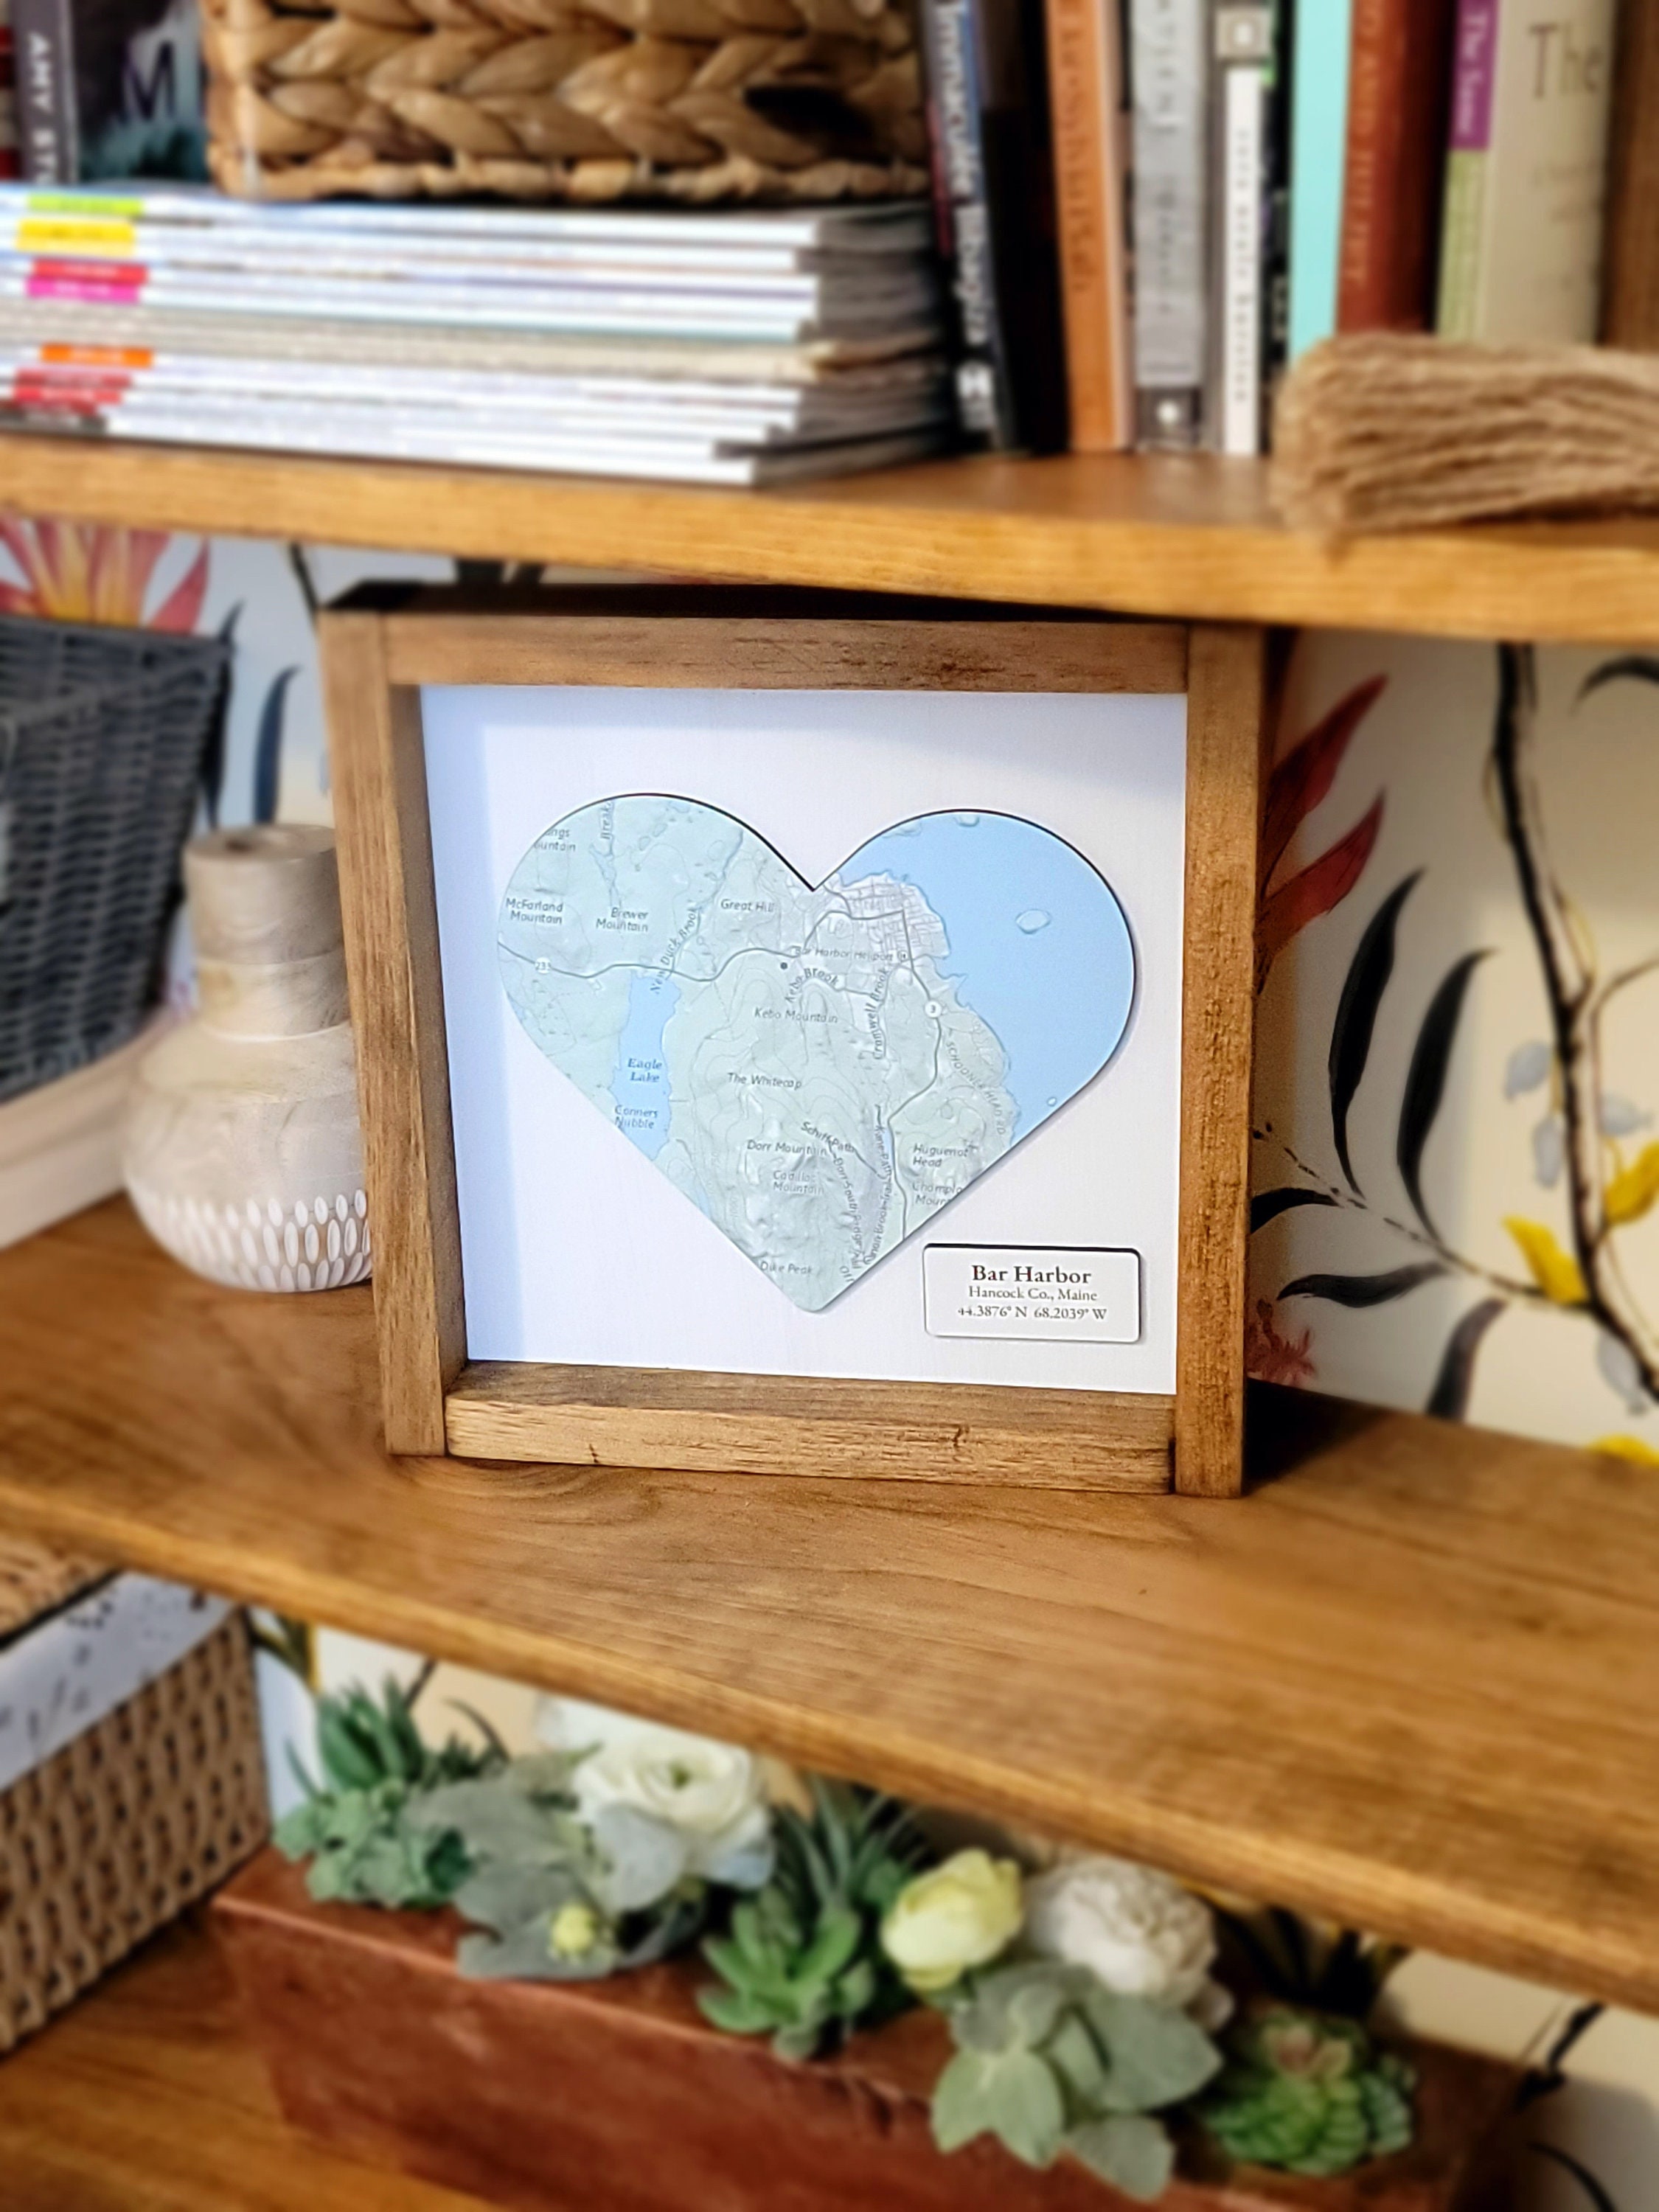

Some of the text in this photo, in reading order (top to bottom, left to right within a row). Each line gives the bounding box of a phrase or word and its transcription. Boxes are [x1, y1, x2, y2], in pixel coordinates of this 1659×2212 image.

[1528, 21, 1604, 99] The
[28, 32, 52, 111] AMY
[506, 897, 564, 913] McFarland
[720, 899, 776, 913] Great Hill
[510, 910, 563, 925] Mountain
[611, 907, 649, 919] Brewer
[596, 918, 649, 932] Mountain
[661, 938, 680, 965] Duck
[804, 968, 840, 987] Brook
[754, 1006, 838, 1023] Kebo Mountain
[627, 1057, 663, 1069] Eagle
[630, 1071, 660, 1082] Lake
[728, 1072, 803, 1091] The Whitecap
[615, 1105, 658, 1119] Conners
[615, 1116, 655, 1129] Nubble
[801, 1121, 832, 1144] Schiff
[747, 1139, 827, 1156] Dorr Mountain
[913, 1143, 969, 1158] Huguenot
[913, 1156, 943, 1168] Head
[773, 1181, 824, 1194] Mountain
[787, 1263, 813, 1275] Peak
[972, 1265, 1091, 1284] Bar Harbor
[968, 1285, 1098, 1303] Hancock Co., Maine
[1015, 1307, 1027, 1318] N
[1034, 1307, 1090, 1319] 68.2039°
[1093, 1308, 1107, 1320] W
